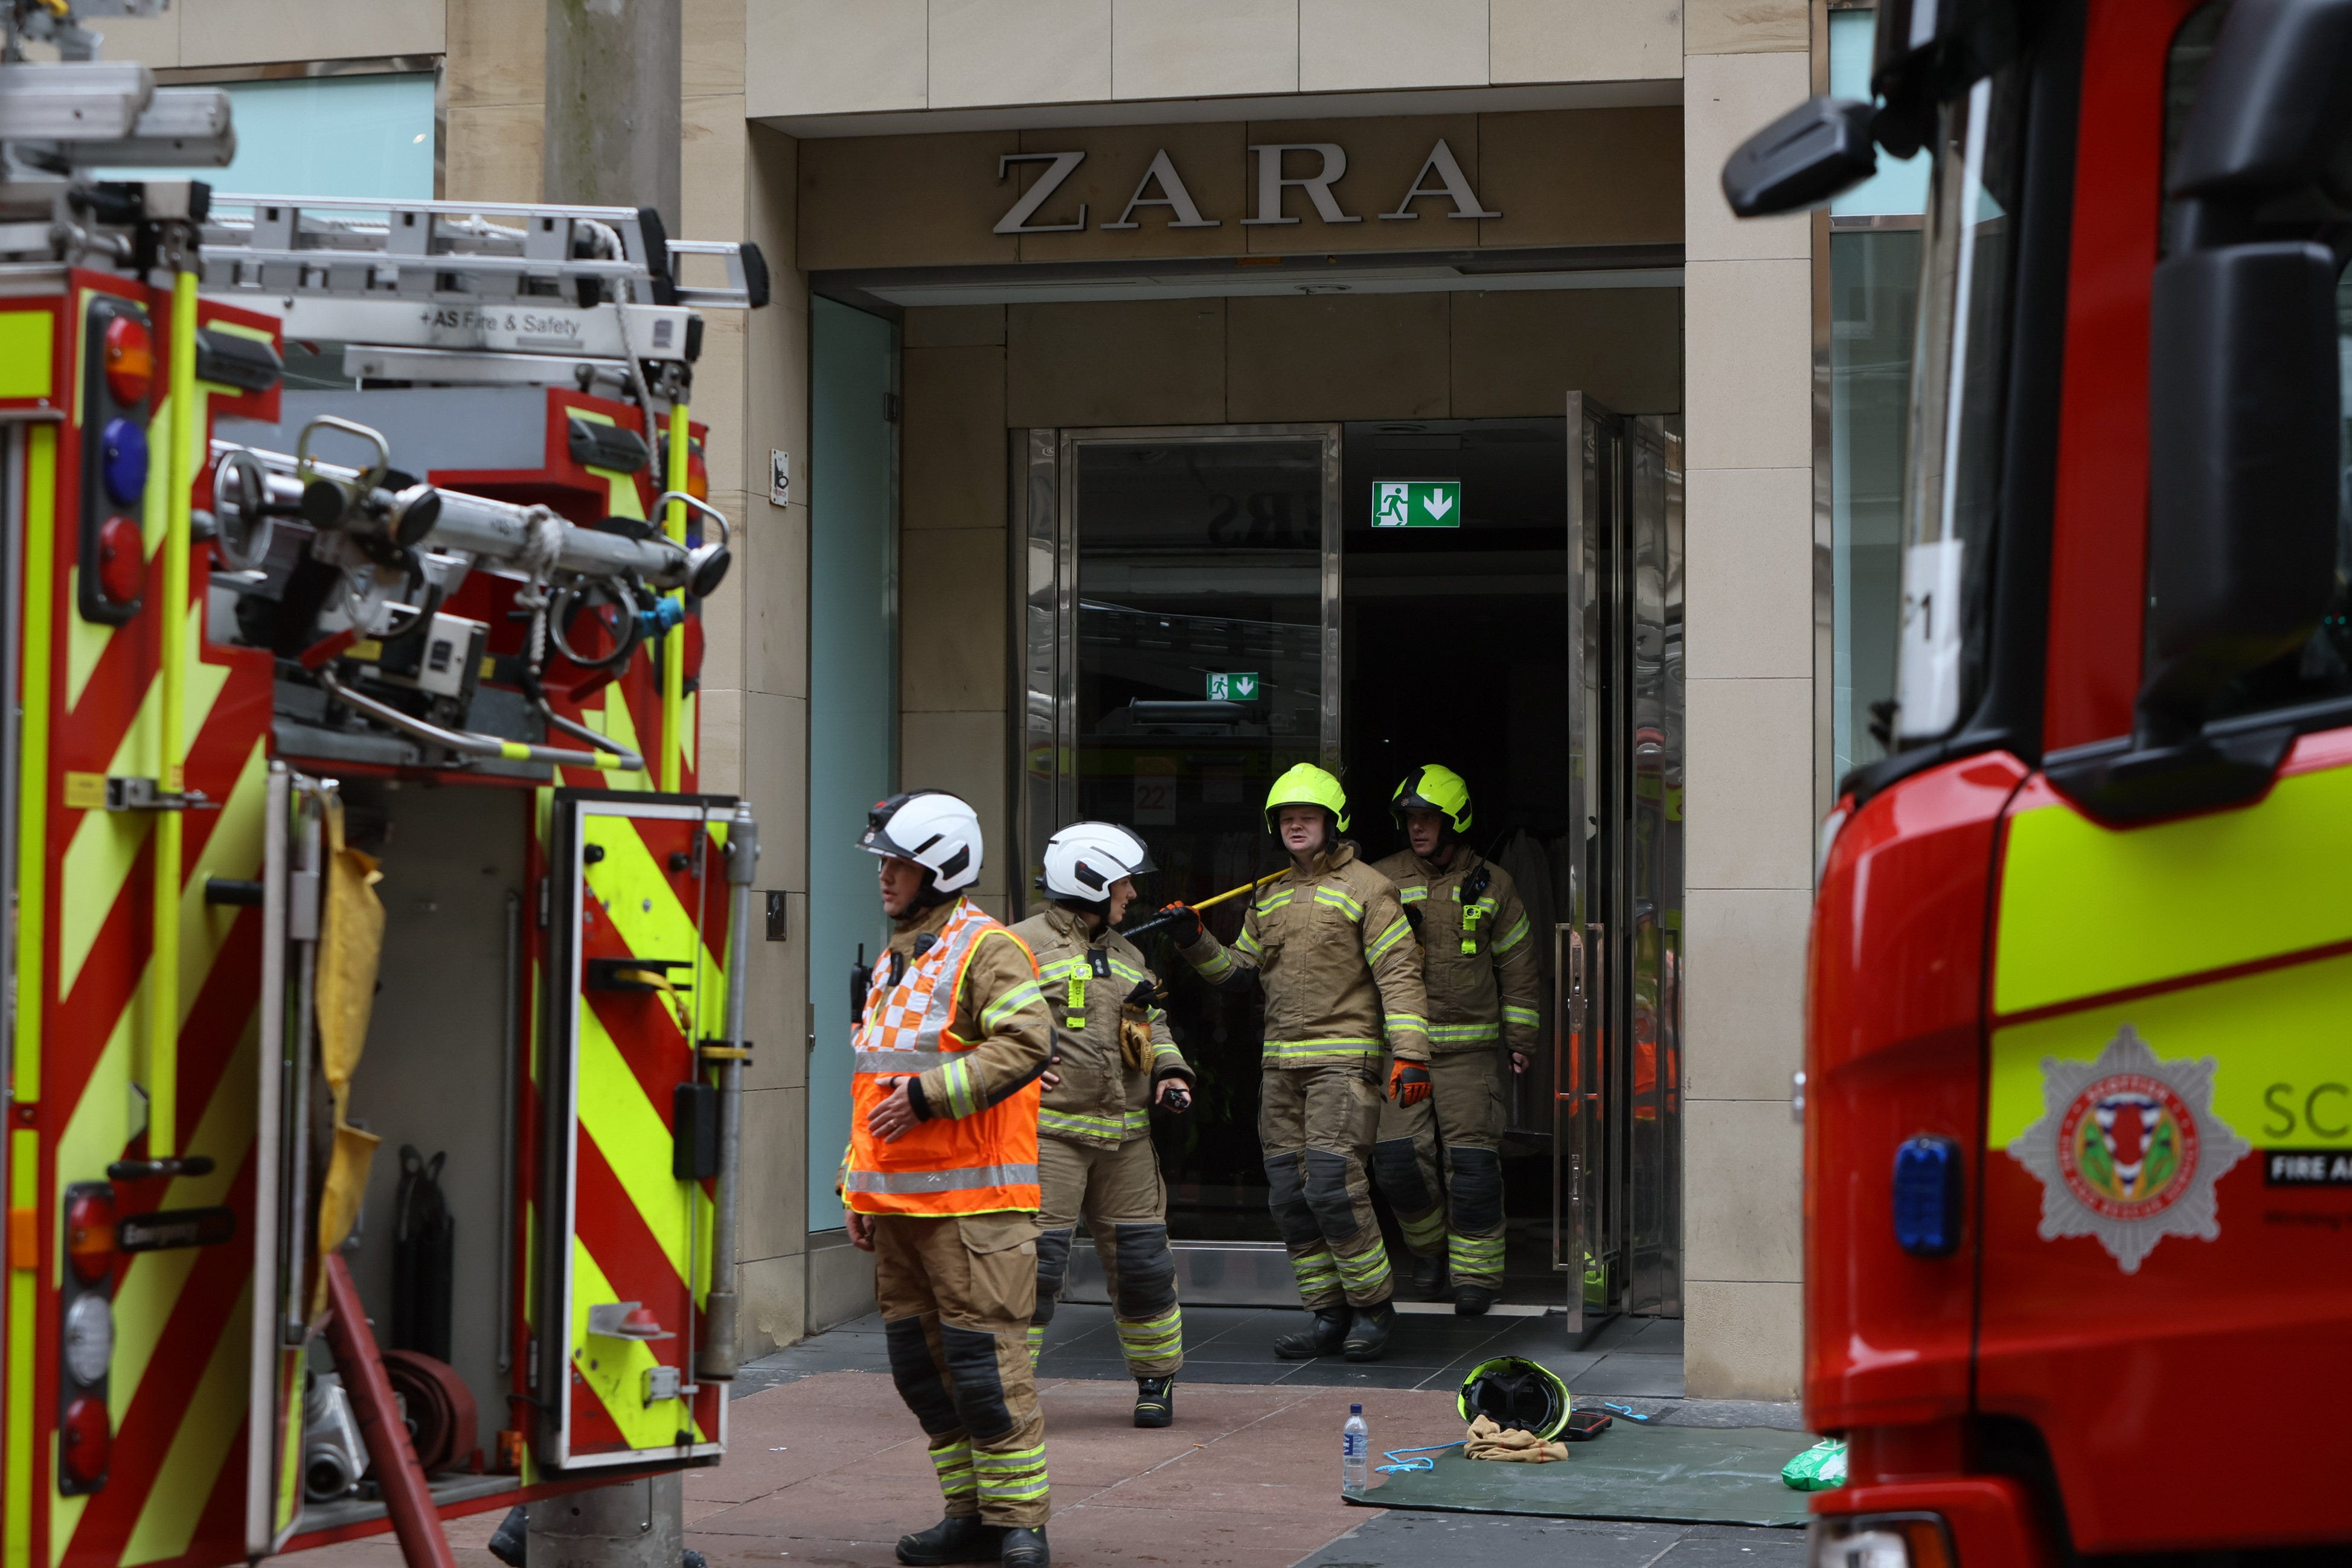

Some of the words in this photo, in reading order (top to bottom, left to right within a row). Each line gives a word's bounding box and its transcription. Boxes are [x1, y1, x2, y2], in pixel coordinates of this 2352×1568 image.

[993, 138, 1503, 235] ZARA
[463, 311, 498, 331] Fire
[504, 313, 517, 332] &
[523, 313, 581, 338] Safety
[2263, 1082, 2350, 1140] SC
[2271, 1154, 2325, 1181] FIRE
